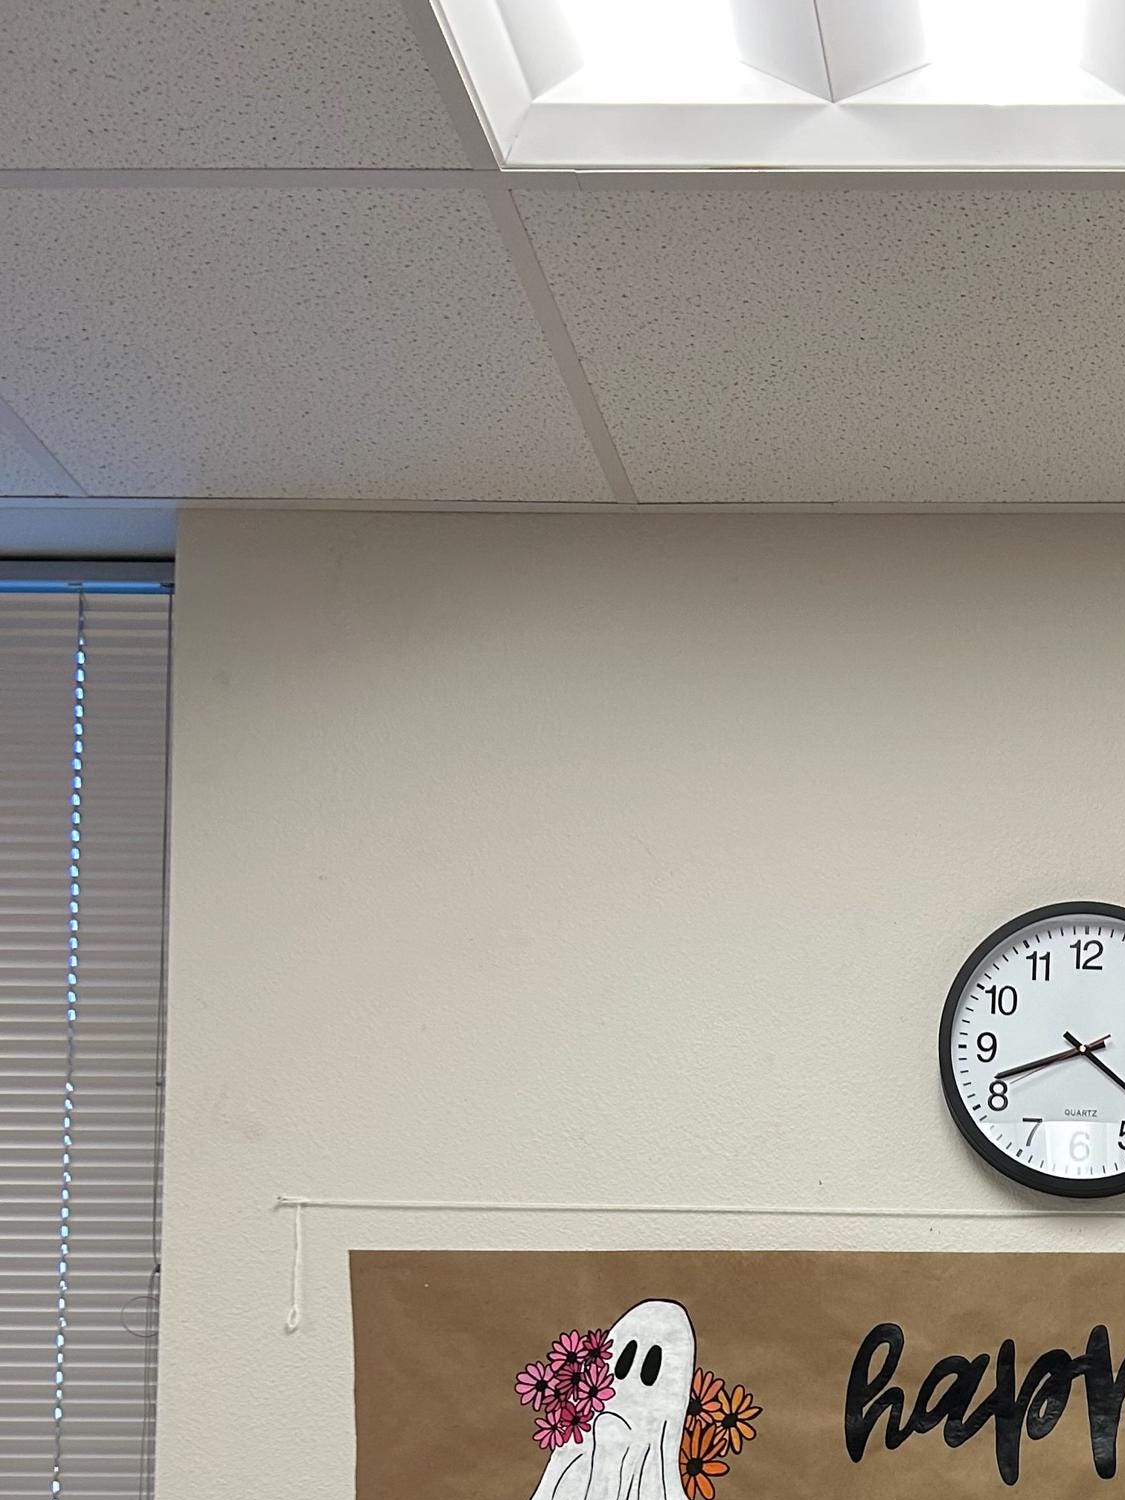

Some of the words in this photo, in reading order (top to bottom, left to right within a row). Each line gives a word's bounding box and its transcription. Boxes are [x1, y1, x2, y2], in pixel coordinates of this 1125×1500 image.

[1026, 951, 1051, 981] 11
[1070, 940, 1104, 971] 12
[985, 985, 1018, 1016] 10
[976, 1031, 998, 1063] 9
[987, 1080, 1009, 1112] 8
[1064, 1108, 1098, 1118] QUARTZ
[1022, 1118, 1043, 1147] 7
[1069, 1131, 1091, 1162] 6
